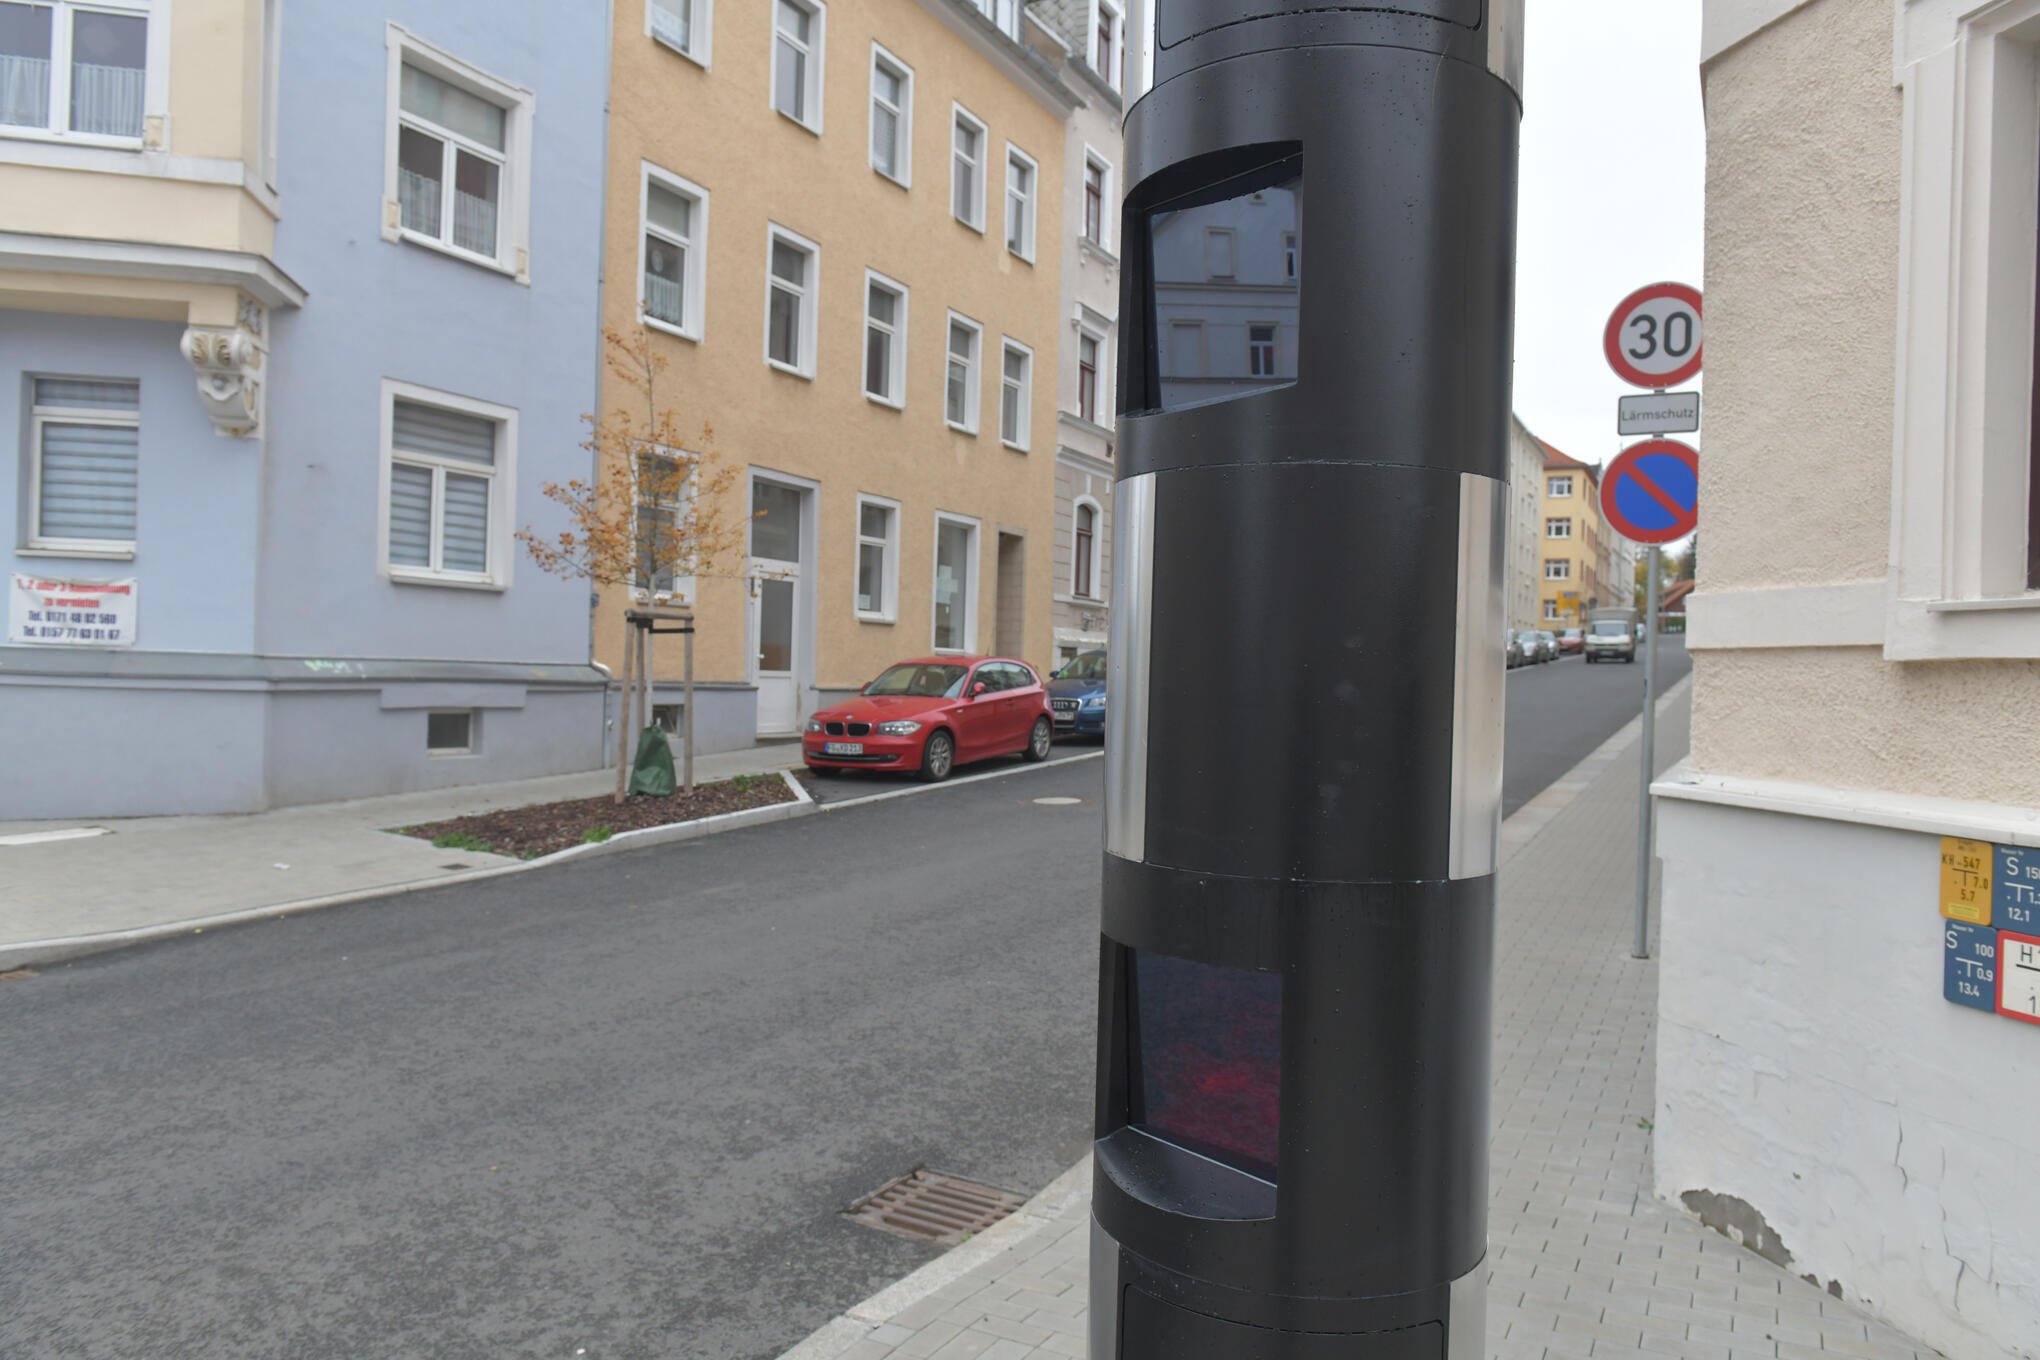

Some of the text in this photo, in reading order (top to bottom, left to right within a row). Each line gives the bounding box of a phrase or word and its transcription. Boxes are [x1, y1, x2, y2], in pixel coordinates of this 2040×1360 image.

[1629, 311, 1692, 359] 30
[1622, 408, 1694, 422] Lärmschutz
[28, 610, 42, 621] Tel.
[24, 625, 37, 636] Tel.
[2006, 856, 2019, 875] S
[1960, 889, 1976, 902] 5.7
[2007, 907, 2030, 922] 12.1
[1946, 930, 1994, 958] S 100
[1976, 967, 1993, 982] 0.9
[1958, 981, 1980, 997] 13.4
